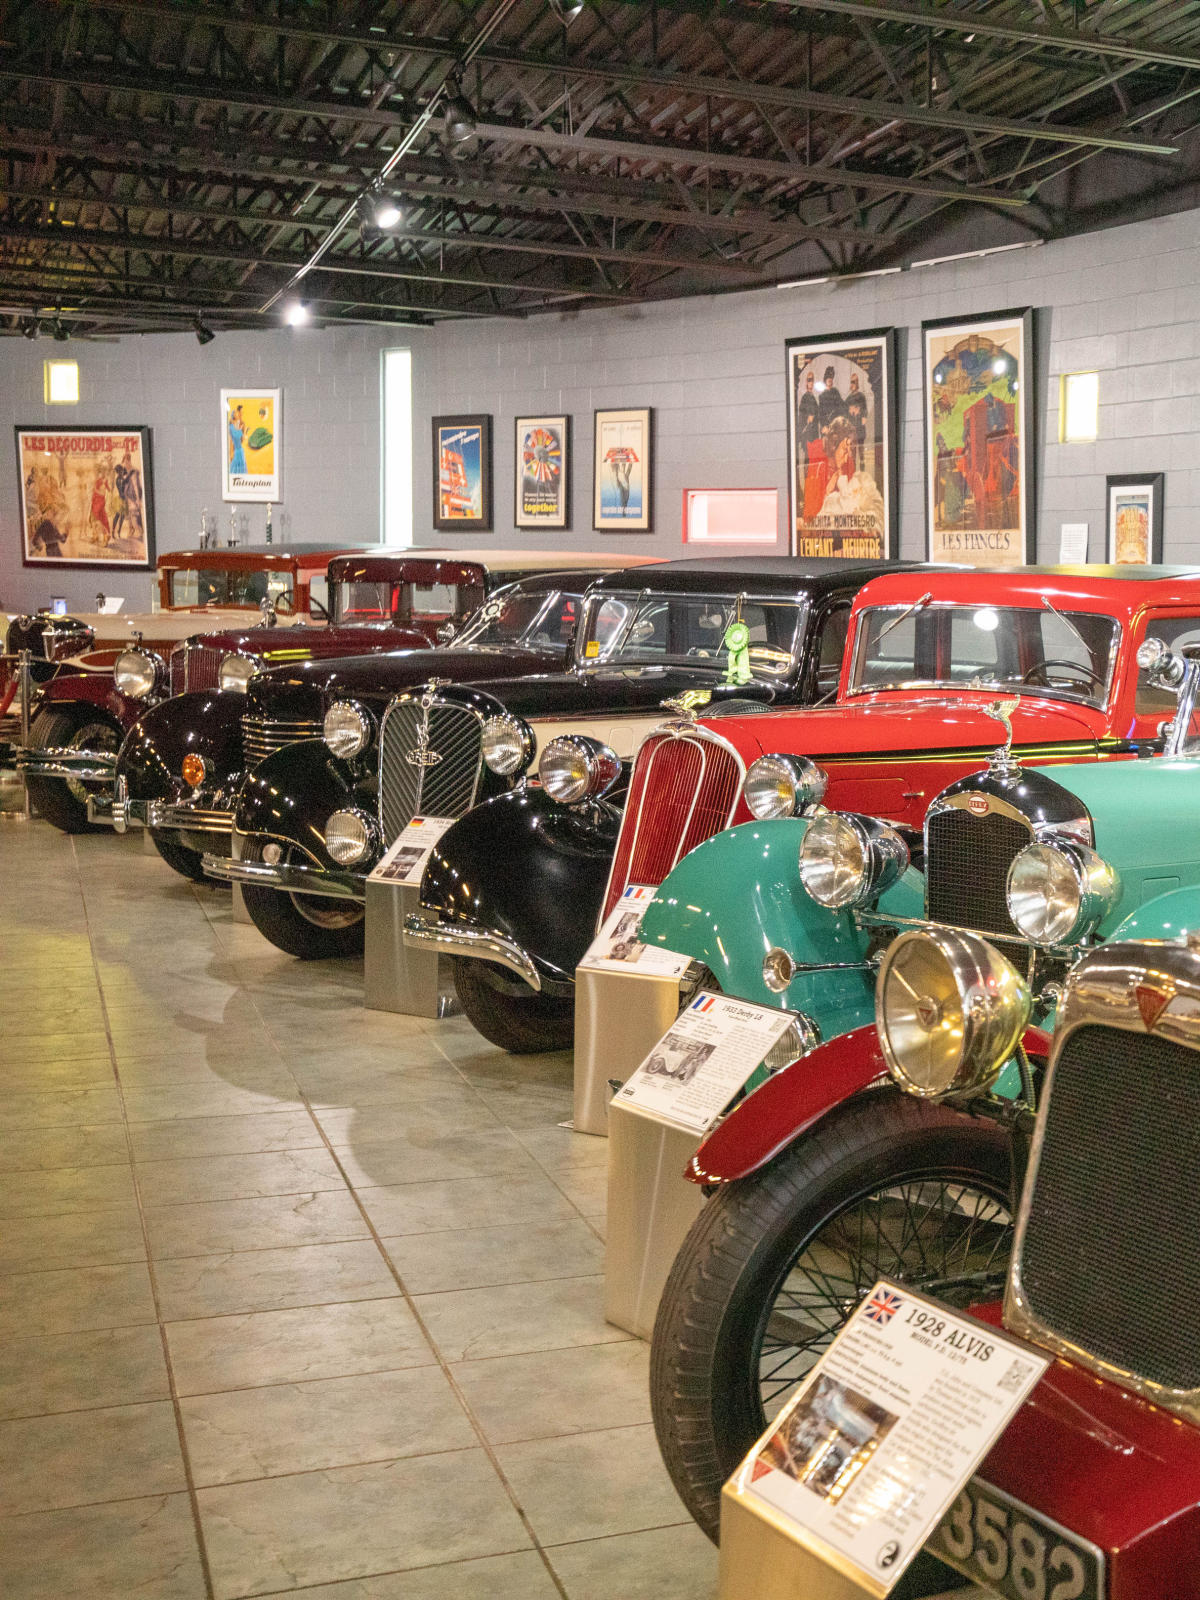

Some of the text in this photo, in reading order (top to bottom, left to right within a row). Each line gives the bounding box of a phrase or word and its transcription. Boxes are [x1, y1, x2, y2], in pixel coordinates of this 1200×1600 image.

[24, 437, 45, 451] LES
[524, 502, 558, 515] together
[834, 514, 876, 528] MONTENEGRO
[942, 533, 962, 550] LES
[905, 1308, 995, 1362] 1928 ALVIS
